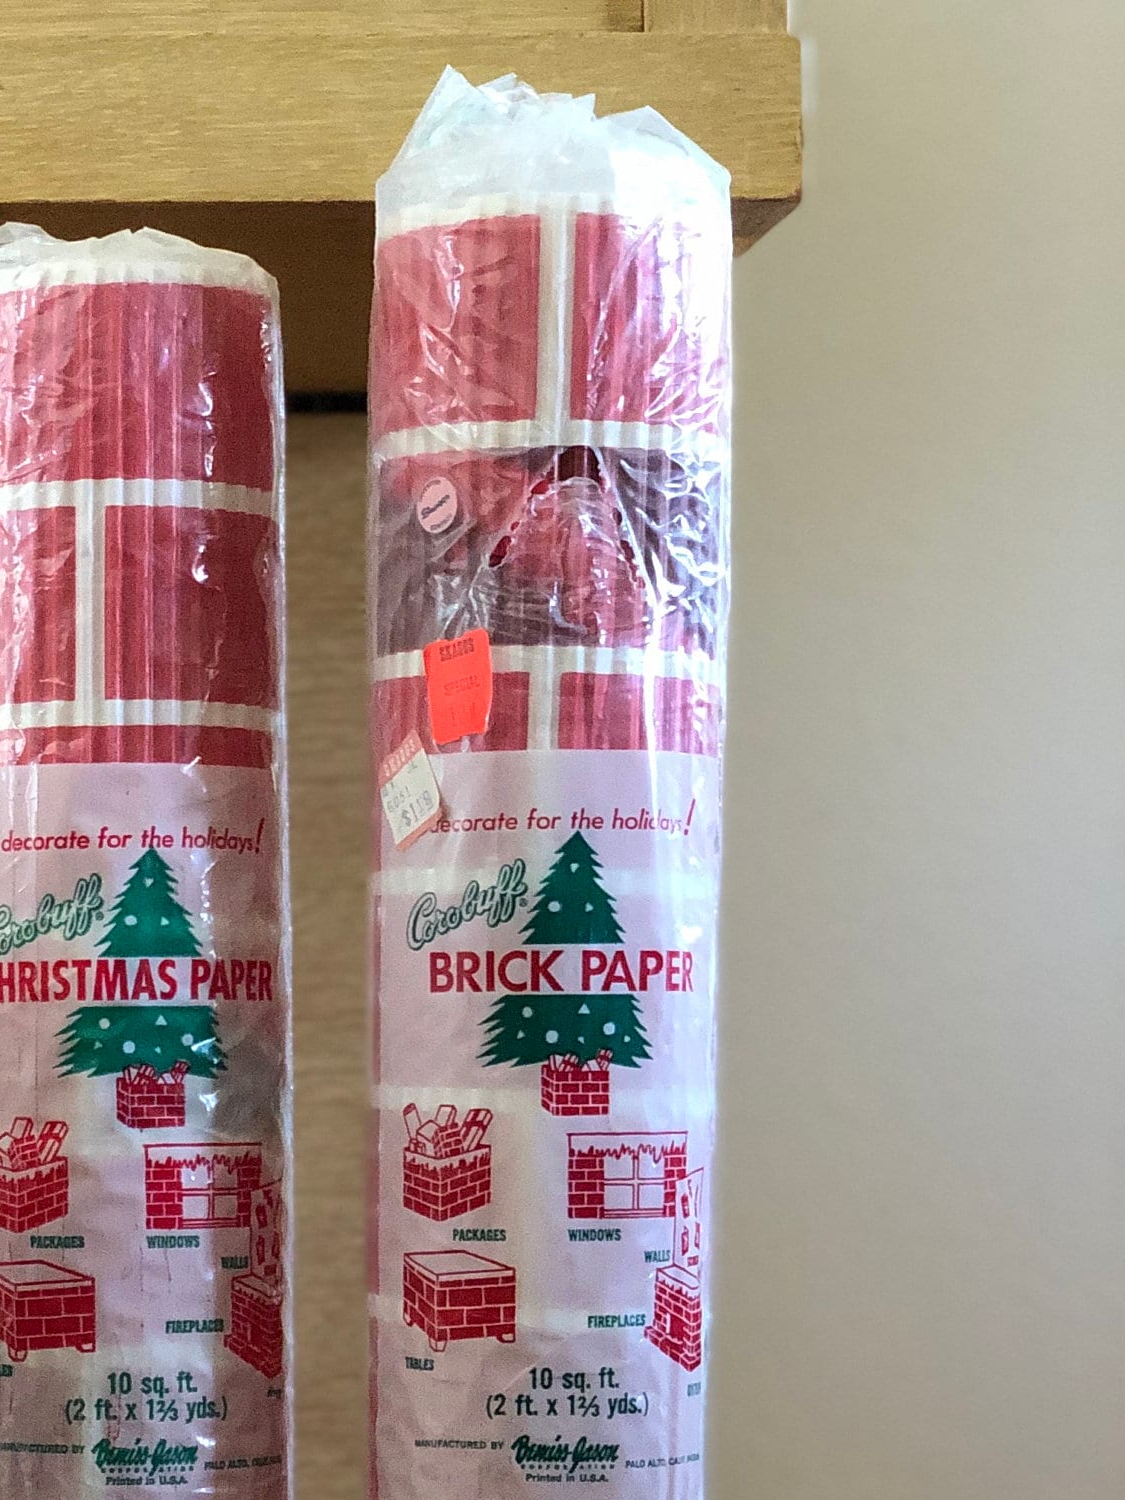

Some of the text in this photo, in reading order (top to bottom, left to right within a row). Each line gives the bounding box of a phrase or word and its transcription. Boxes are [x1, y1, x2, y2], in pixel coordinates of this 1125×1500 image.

[526, 808, 561, 831] for
[571, 807, 604, 830] the
[612, 799, 696, 836] holidays!
[1, 818, 265, 856] decorate for the holidays!
[429, 949, 694, 993] BRICK PAPER
[190, 959, 273, 1001] PAPER
[30, 1235, 85, 1249] PACKAGES
[146, 1235, 200, 1249] WINDOWS
[452, 1229, 507, 1241] PACKAGES
[568, 1229, 621, 1242] WINDOWS
[644, 1250, 671, 1263] WALLS
[587, 1314, 646, 1328] FIREPLACES
[107, 1370, 198, 1398] 10 sq. ft.
[529, 1367, 620, 1393] 10 sq. ft.
[65, 1397, 86, 1425] (2
[93, 1398, 118, 1421] ft.
[125, 1402, 137, 1421] x
[185, 1396, 228, 1424] yds.)
[486, 1392, 507, 1420] (2
[515, 1393, 538, 1416] ft.
[546, 1398, 558, 1416] x
[607, 1391, 649, 1420] yds.)
[72, 1444, 85, 1454] BY
[415, 1440, 504, 1450] MANUFACTURED BY
[106, 1476, 143, 1486] Printed
[146, 1476, 155, 1485] in
[525, 1473, 609, 1483] Printed in U.S.A.
